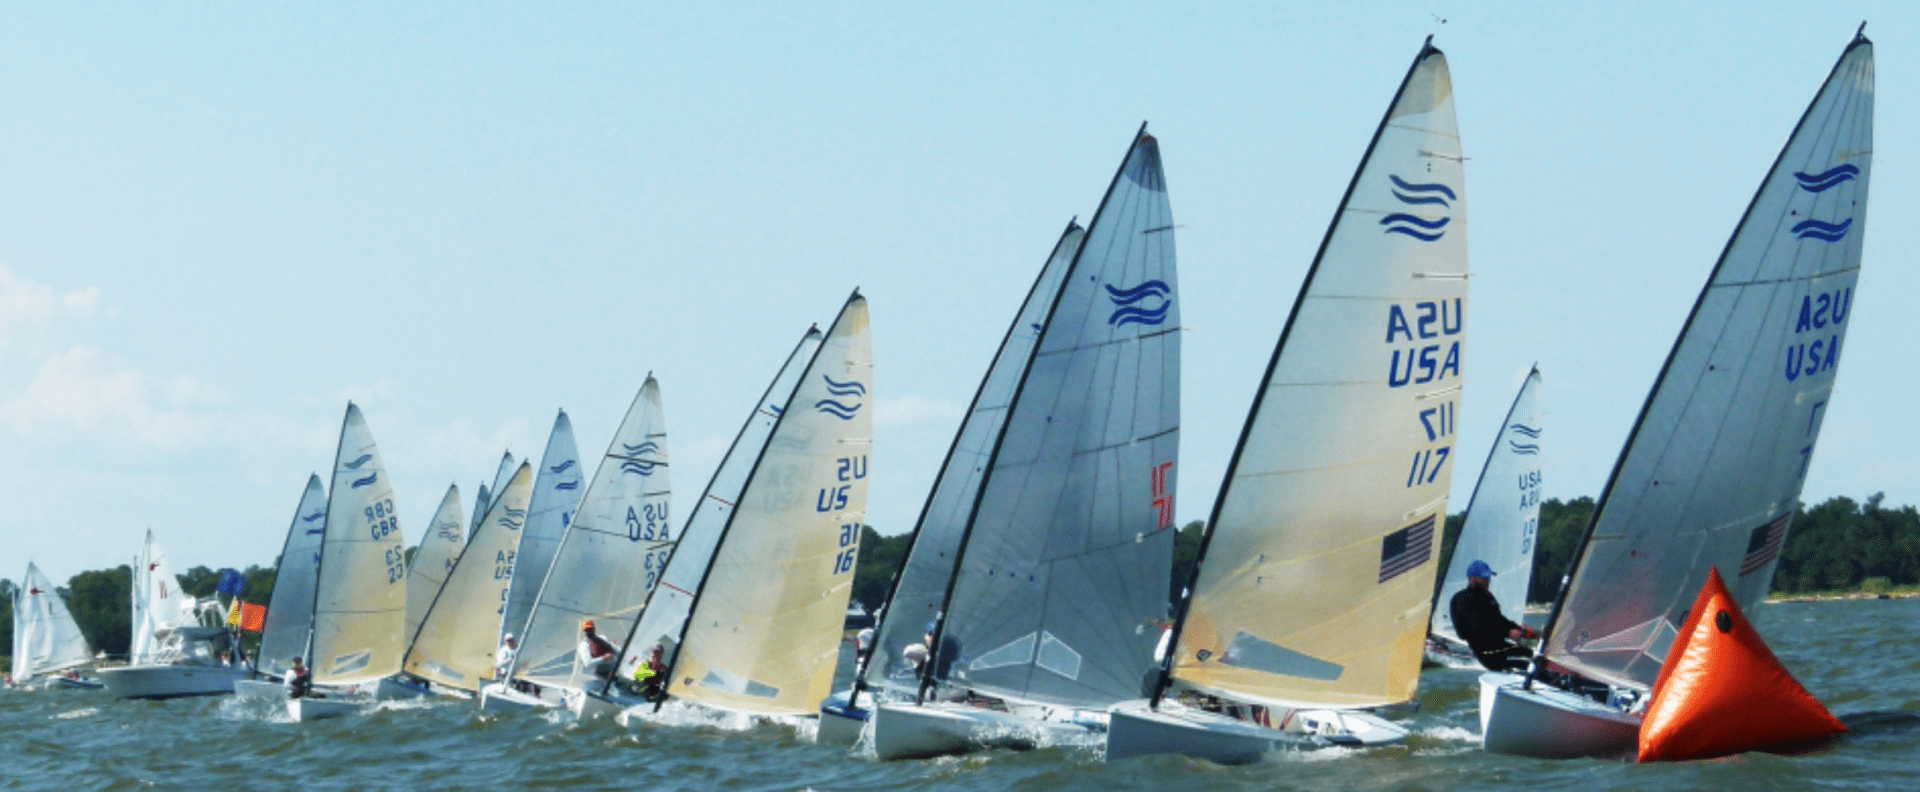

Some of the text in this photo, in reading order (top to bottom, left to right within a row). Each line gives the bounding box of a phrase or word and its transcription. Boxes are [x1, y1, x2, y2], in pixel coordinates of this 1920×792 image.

[1388, 341, 1460, 388] USA
[1785, 334, 1838, 382] USA
[1407, 446, 1451, 488] 117
[816, 484, 852, 513] US
[629, 522, 669, 542] USA
[833, 548, 856, 575] 16
